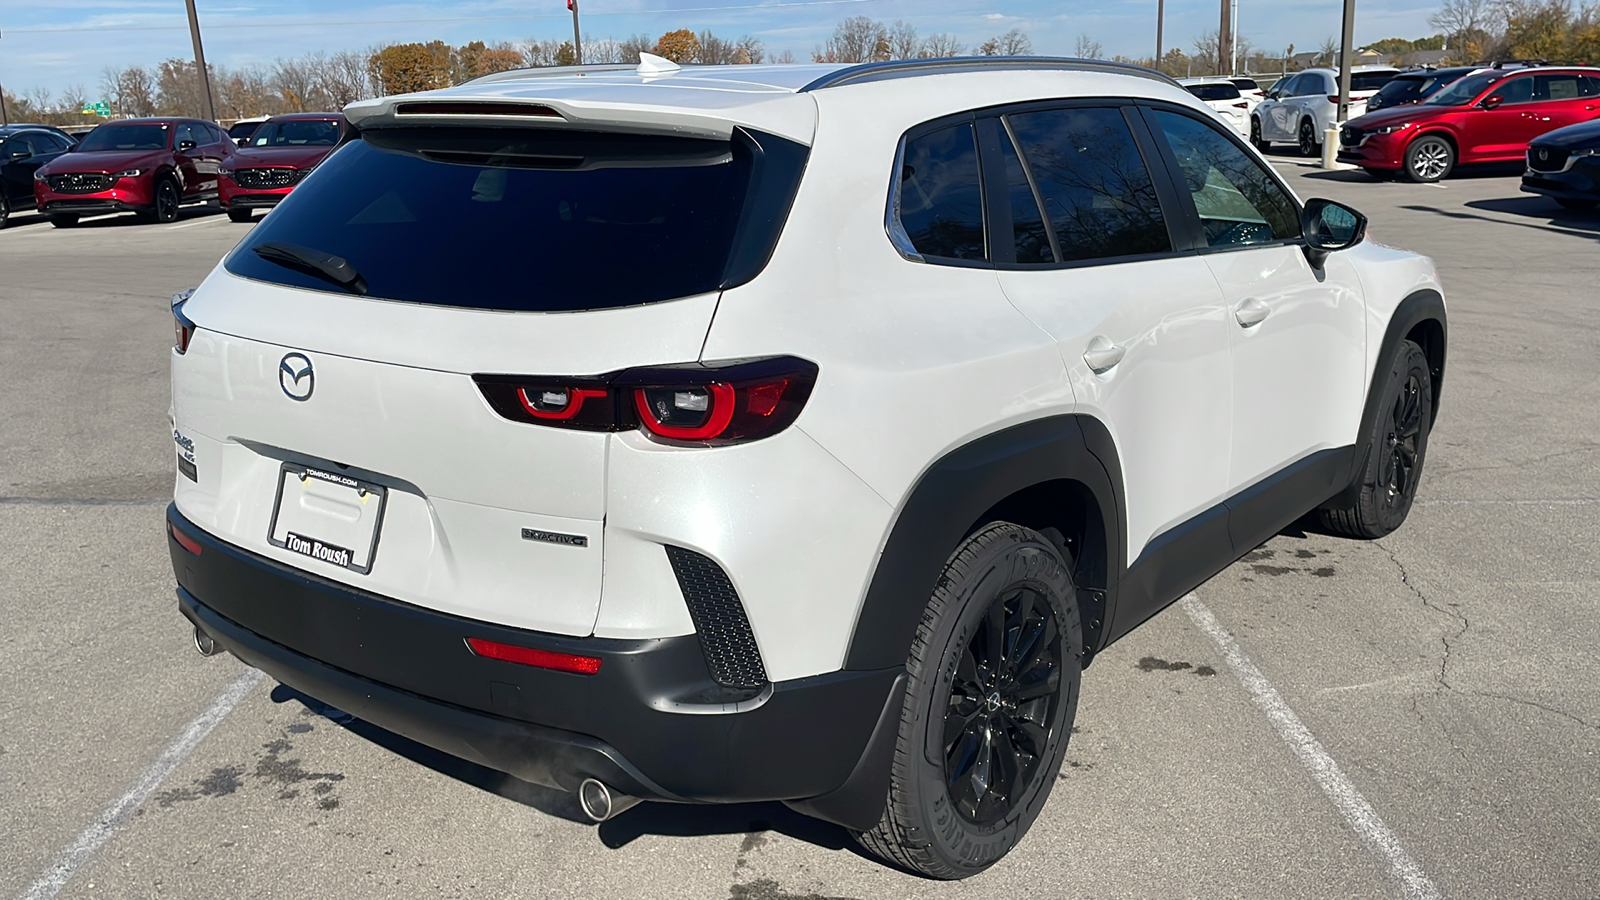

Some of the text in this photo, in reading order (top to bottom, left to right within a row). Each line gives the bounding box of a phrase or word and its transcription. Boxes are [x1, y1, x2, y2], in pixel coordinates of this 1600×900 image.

[306, 468, 358, 487] TOMROUSH.COM
[287, 533, 349, 567] Tom Roush
